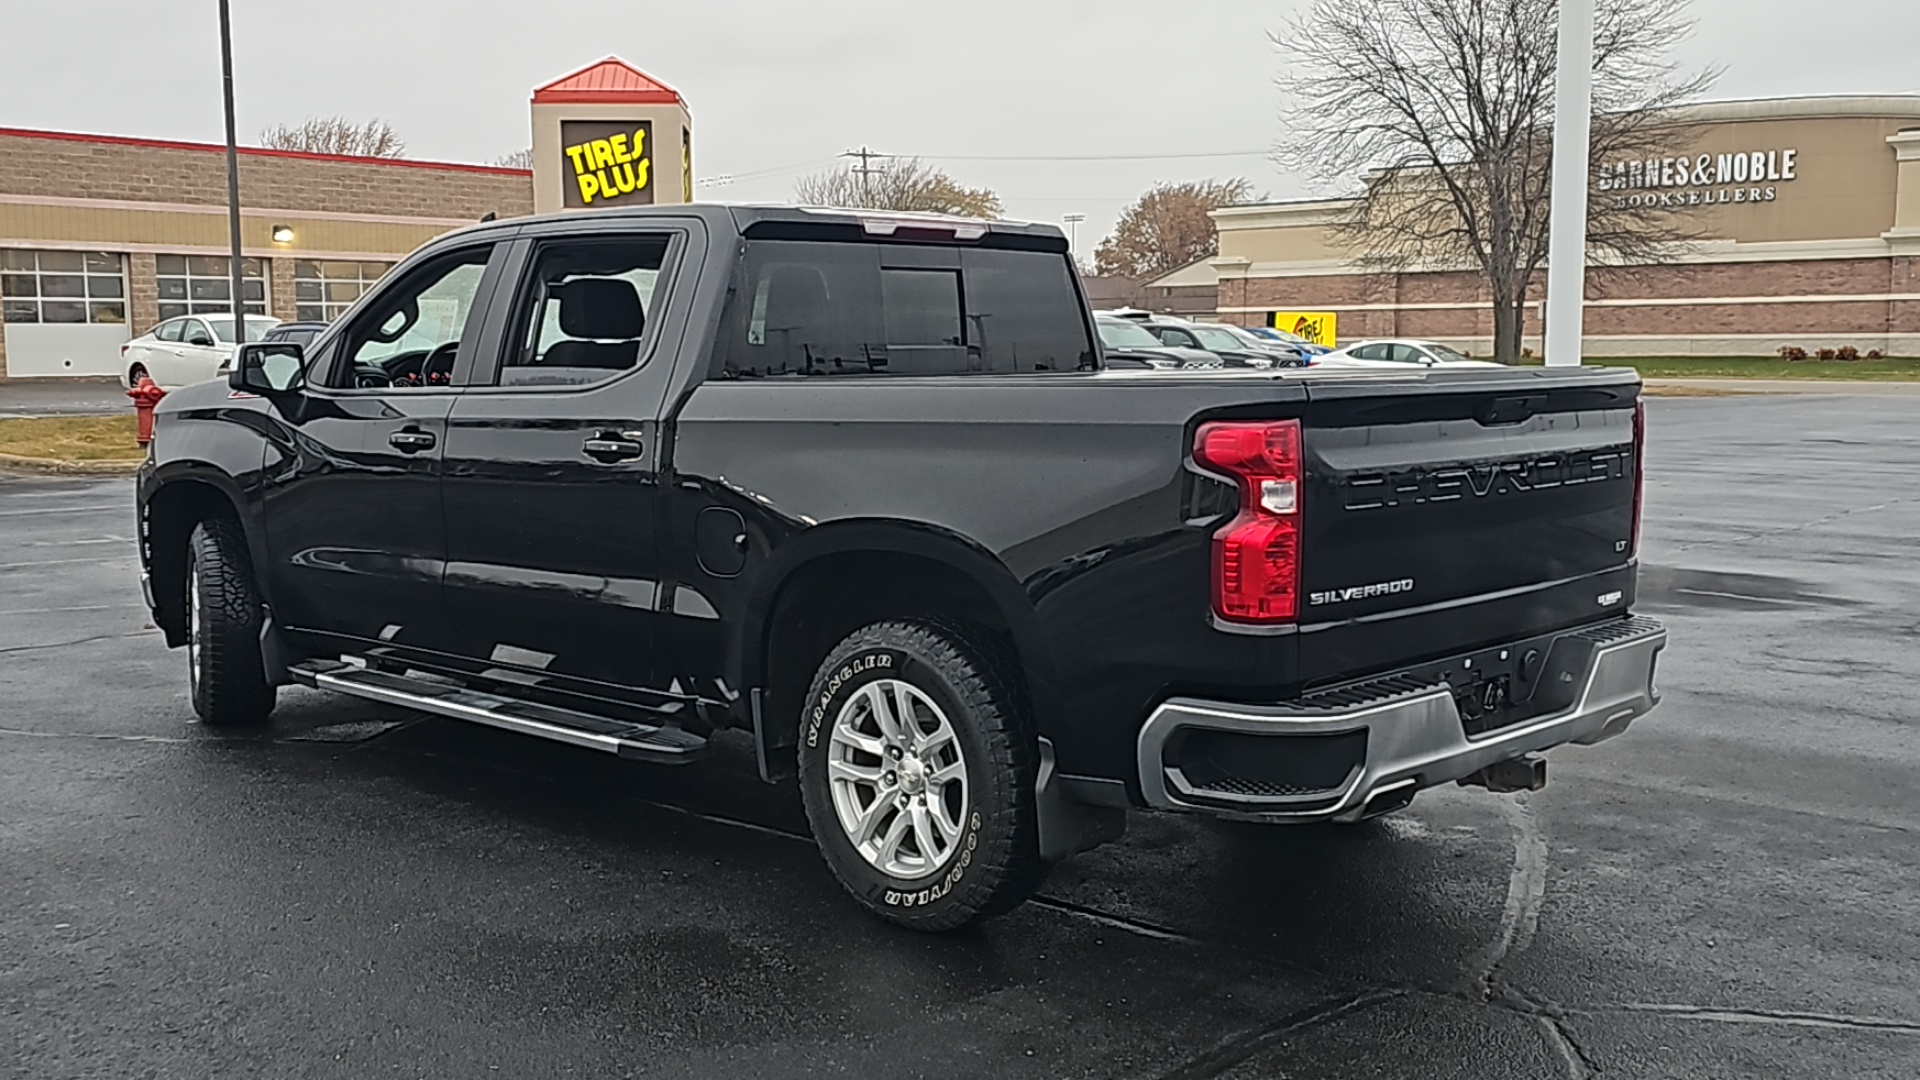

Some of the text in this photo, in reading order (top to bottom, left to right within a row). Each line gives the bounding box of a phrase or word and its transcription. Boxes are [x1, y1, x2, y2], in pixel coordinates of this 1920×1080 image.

[566, 128, 646, 175] TIRES
[577, 157, 650, 203] PLUS
[1616, 187, 1776, 208] BOOKSELLERS
[1345, 452, 1630, 510] CHEVROLET
[1310, 578, 1414, 605] SILVERADO
[807, 654, 892, 748] WRANGLER
[884, 812, 981, 907] GOODYEAR
